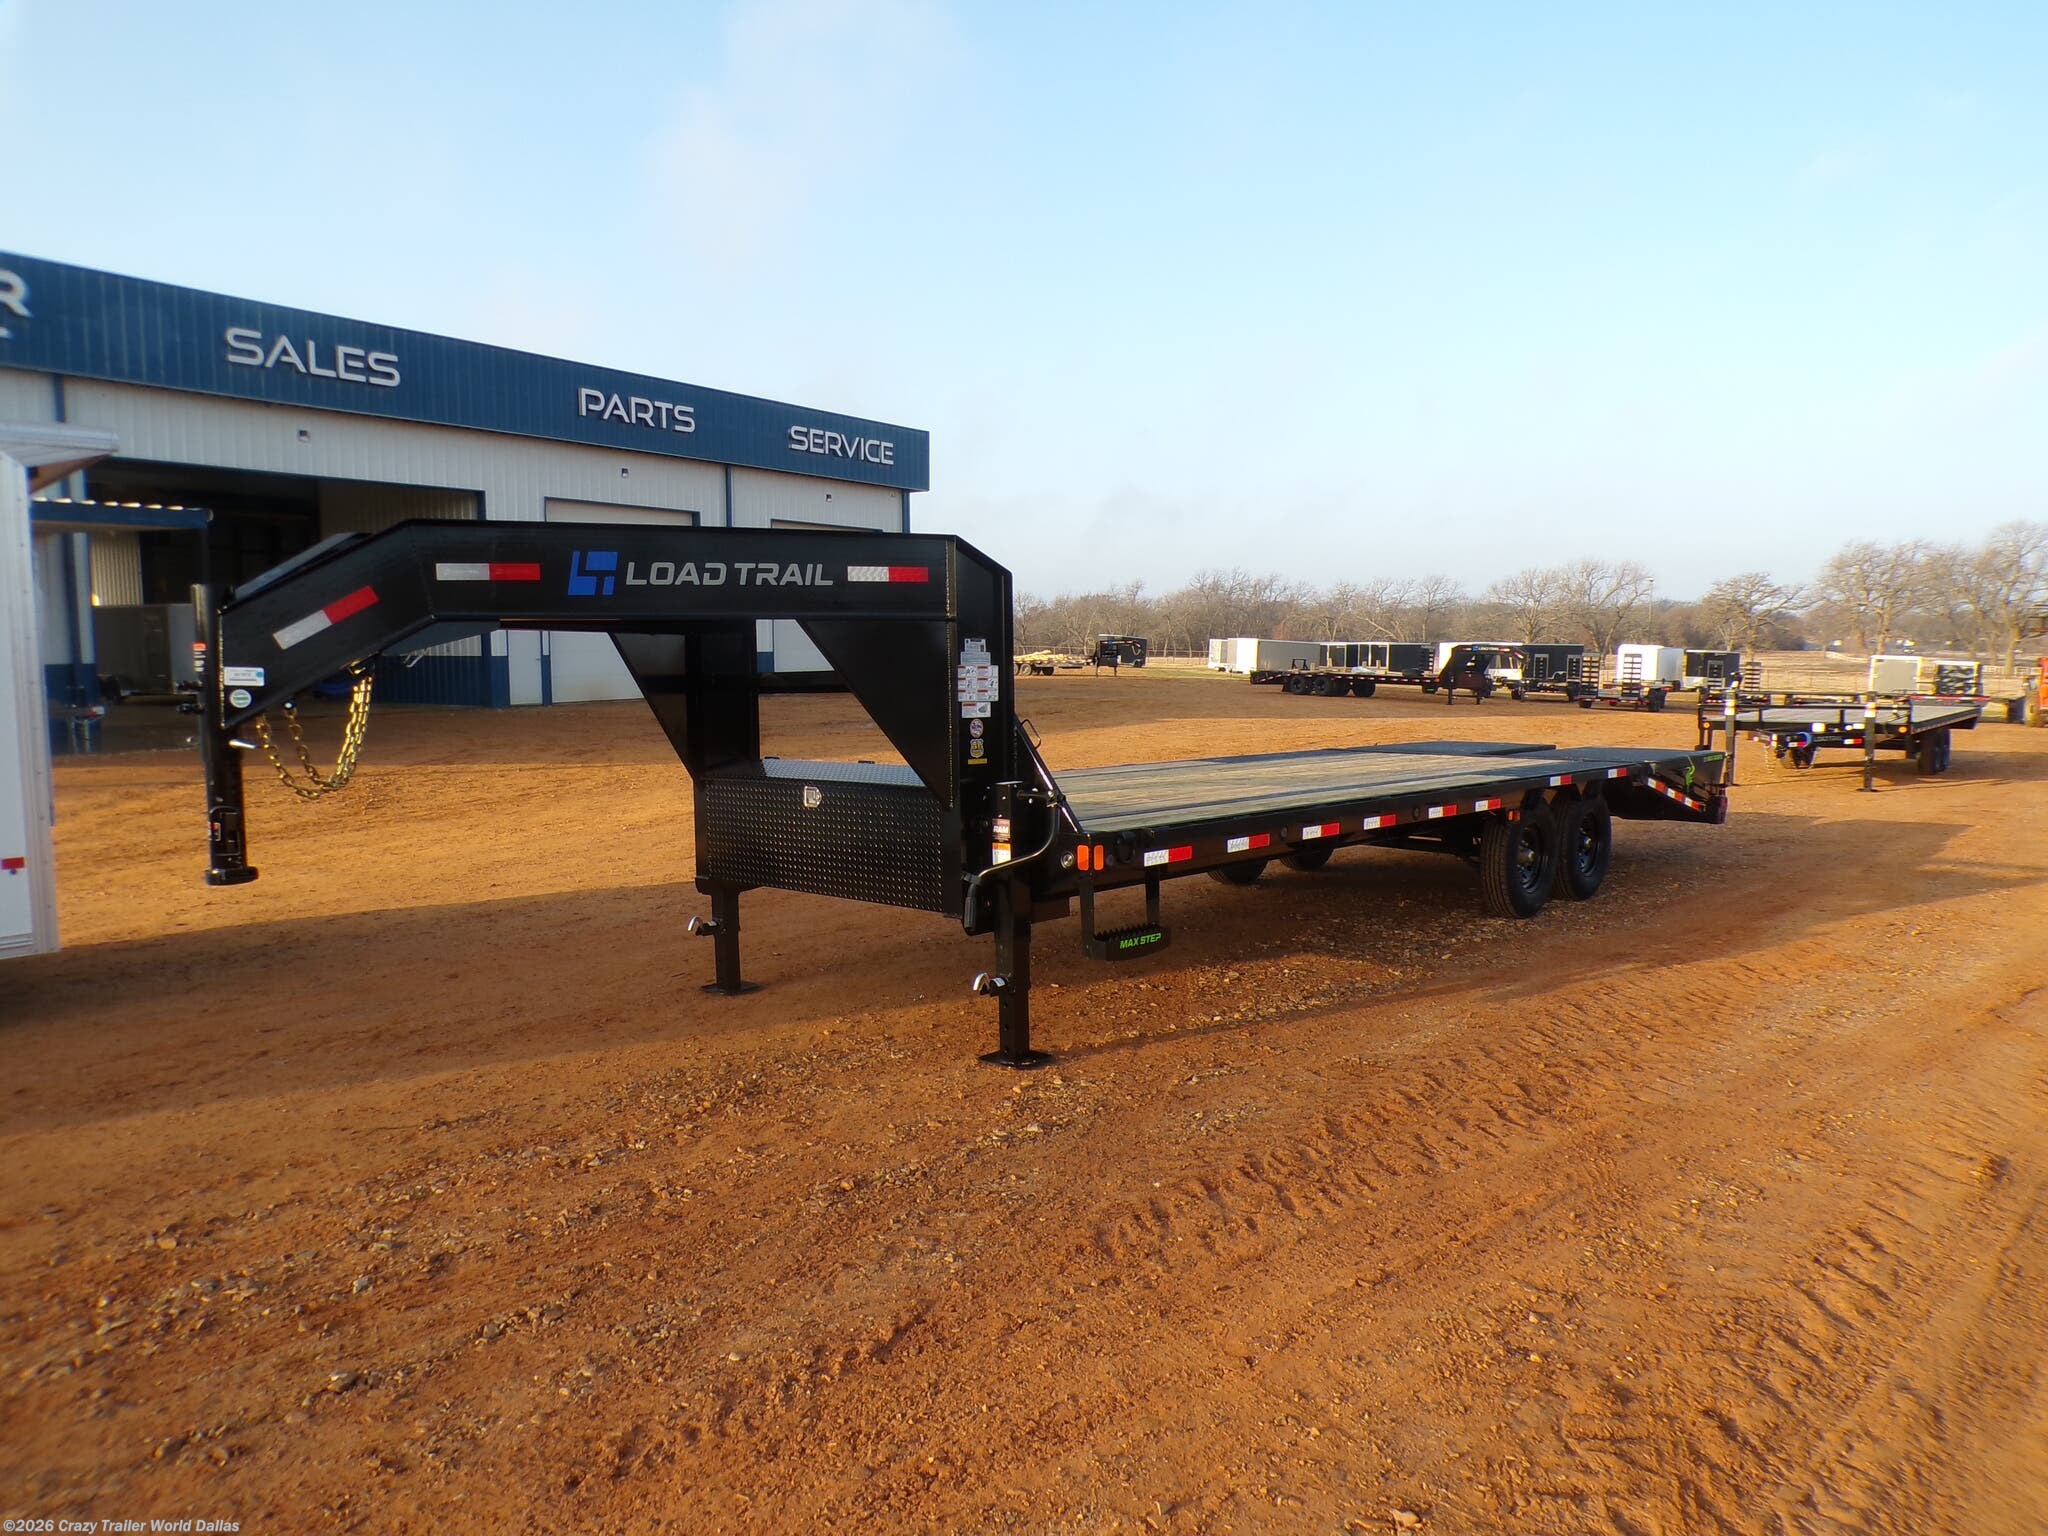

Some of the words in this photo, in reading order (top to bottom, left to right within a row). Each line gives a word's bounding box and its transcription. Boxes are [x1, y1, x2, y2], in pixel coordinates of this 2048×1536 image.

[226, 327, 401, 387] SALES
[579, 387, 696, 433] PARTS
[789, 425, 894, 465] SERVICE
[625, 561, 727, 586] LOAD
[734, 563, 834, 586] TRAIL
[1120, 937, 1139, 949] MAX
[1140, 932, 1161, 945] STEP
